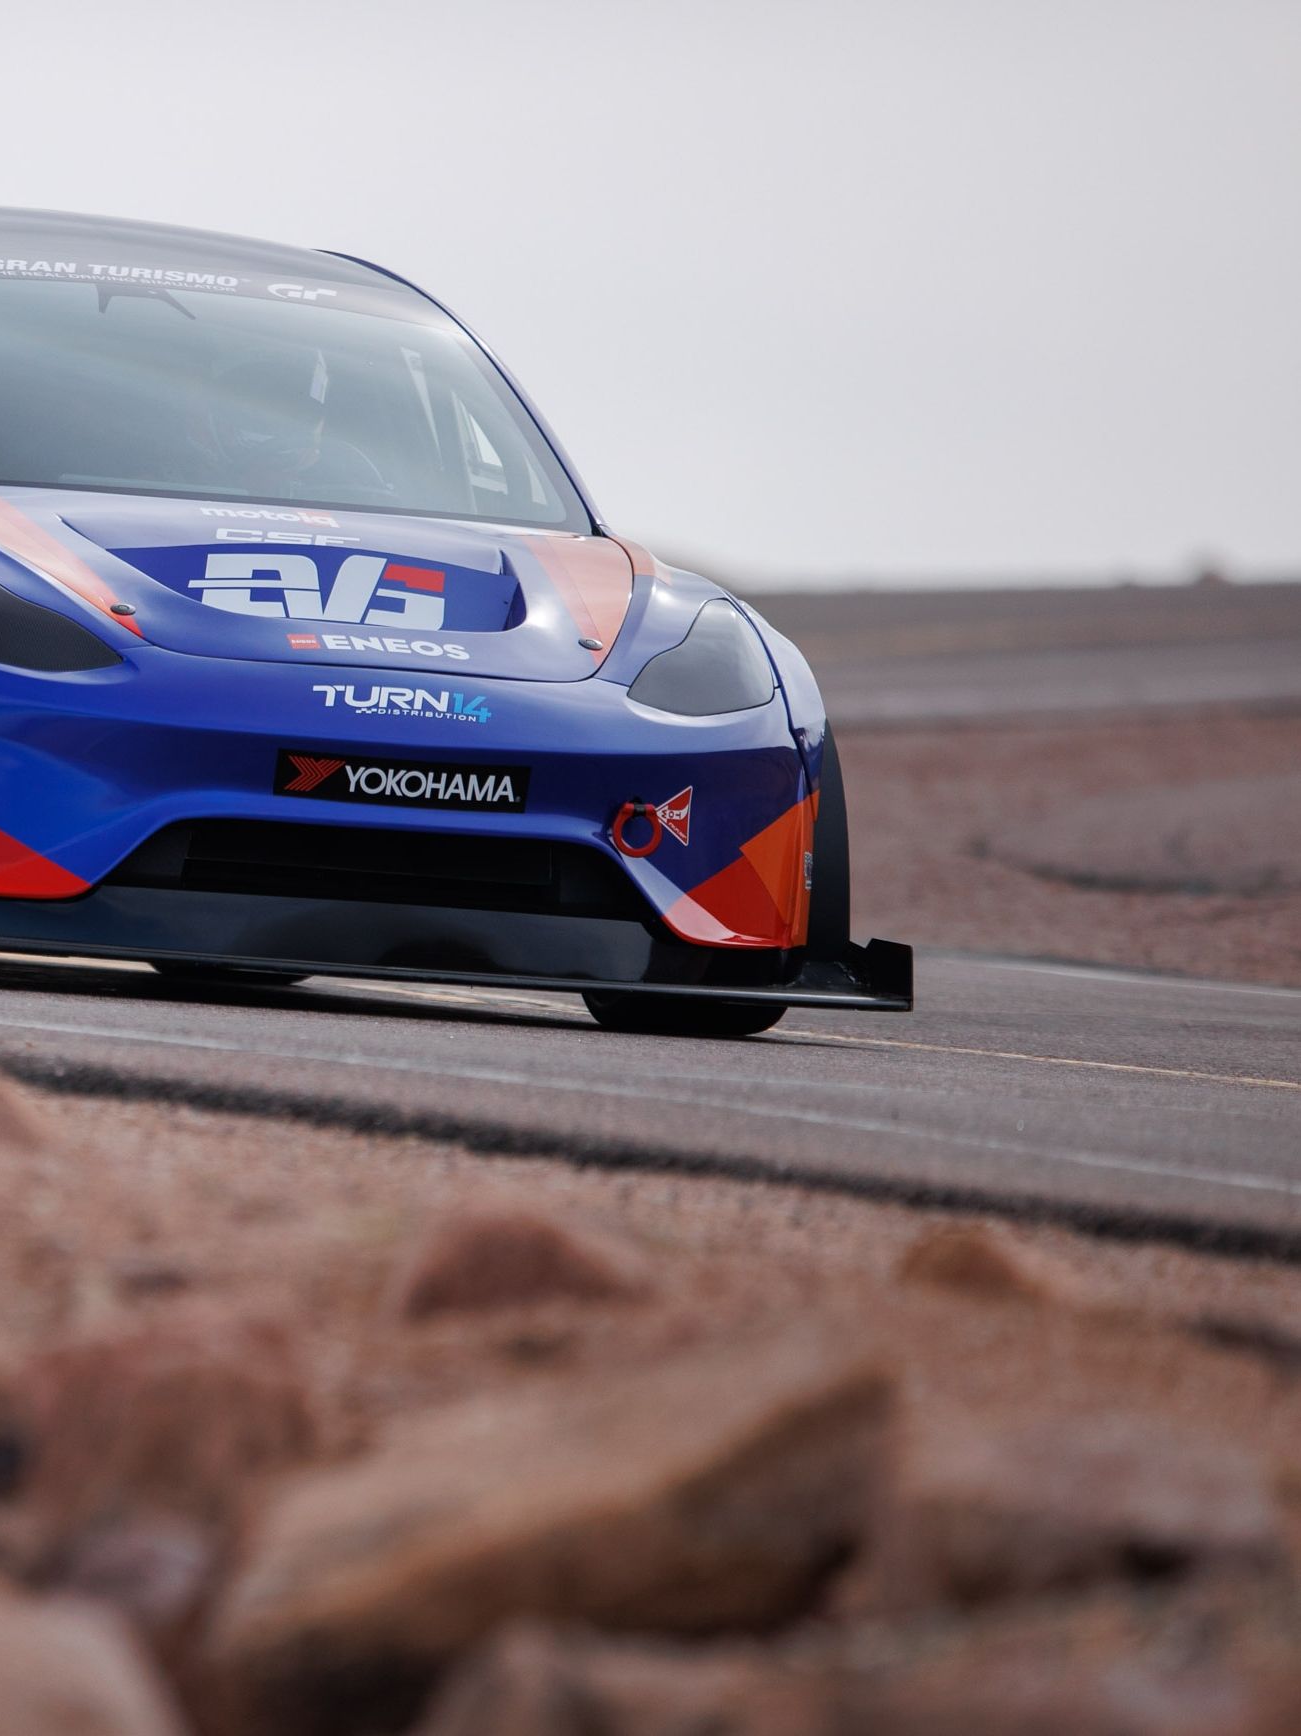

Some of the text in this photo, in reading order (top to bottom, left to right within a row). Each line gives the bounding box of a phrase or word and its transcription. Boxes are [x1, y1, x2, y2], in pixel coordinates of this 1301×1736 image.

[87, 264, 239, 287] TURISMO
[215, 527, 361, 546] CSF
[322, 634, 470, 661] ENEOS
[377, 708, 477, 722] DISTRIBUTION
[345, 765, 514, 803] YOKOHAMA
